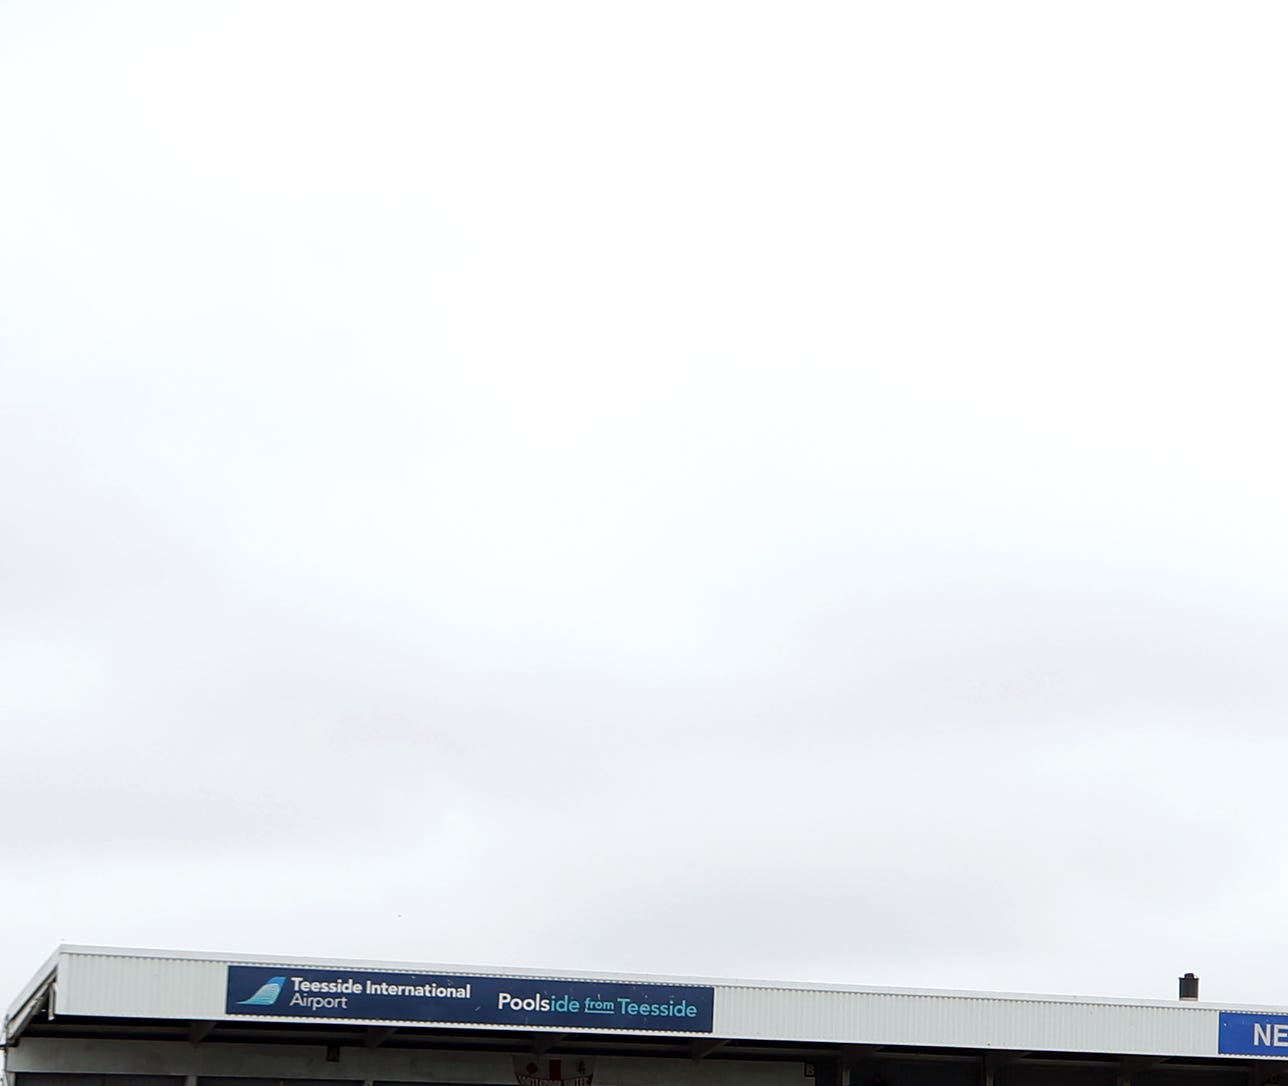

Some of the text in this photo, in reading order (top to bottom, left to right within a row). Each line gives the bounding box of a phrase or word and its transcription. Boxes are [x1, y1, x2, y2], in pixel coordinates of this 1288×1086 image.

[291, 976, 471, 999] Teesside International
[289, 992, 348, 1010] Airport
[497, 993, 698, 1018] Poolside from Teesside
